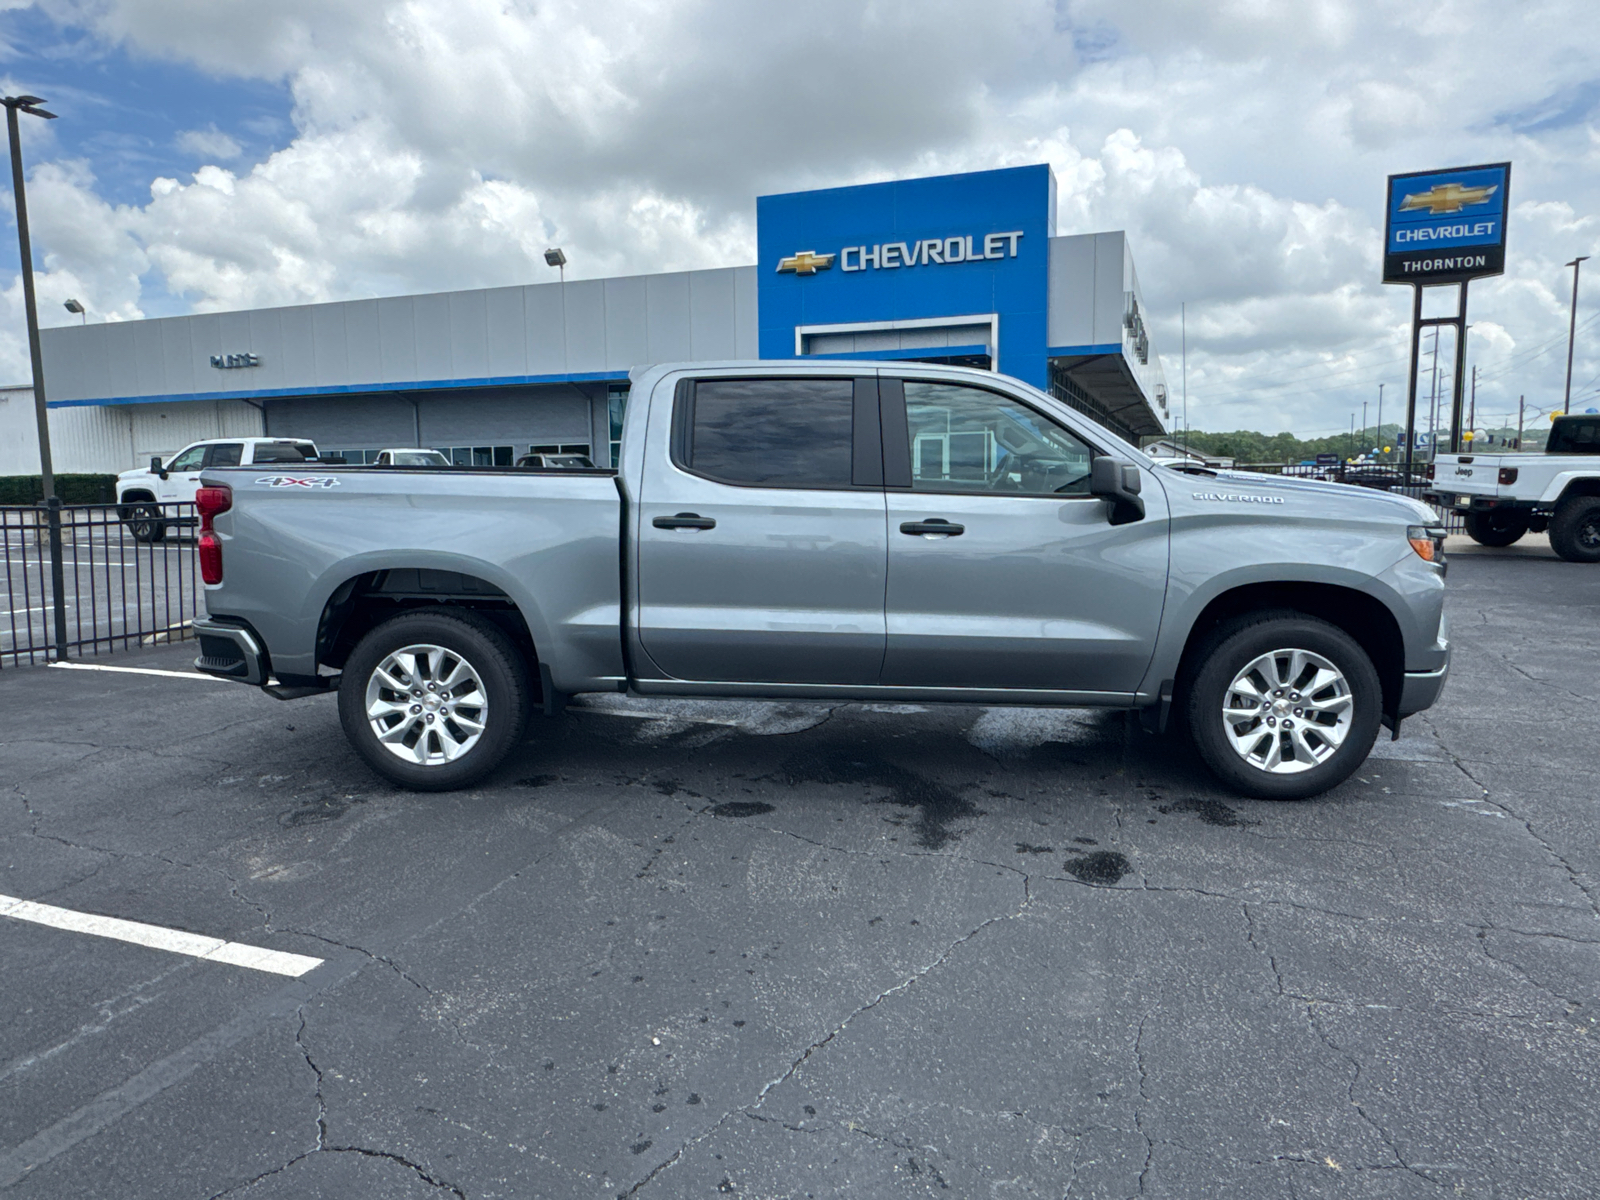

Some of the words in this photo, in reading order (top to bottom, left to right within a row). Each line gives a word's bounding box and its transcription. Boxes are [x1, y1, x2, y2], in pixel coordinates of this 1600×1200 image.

[1395, 222, 1496, 243] CHEVROLET
[840, 230, 1024, 272] CHEVROLET
[1402, 255, 1486, 273] THORNTON
[1455, 467, 1473, 477] Jeep
[1192, 492, 1285, 505] SILVERADO
